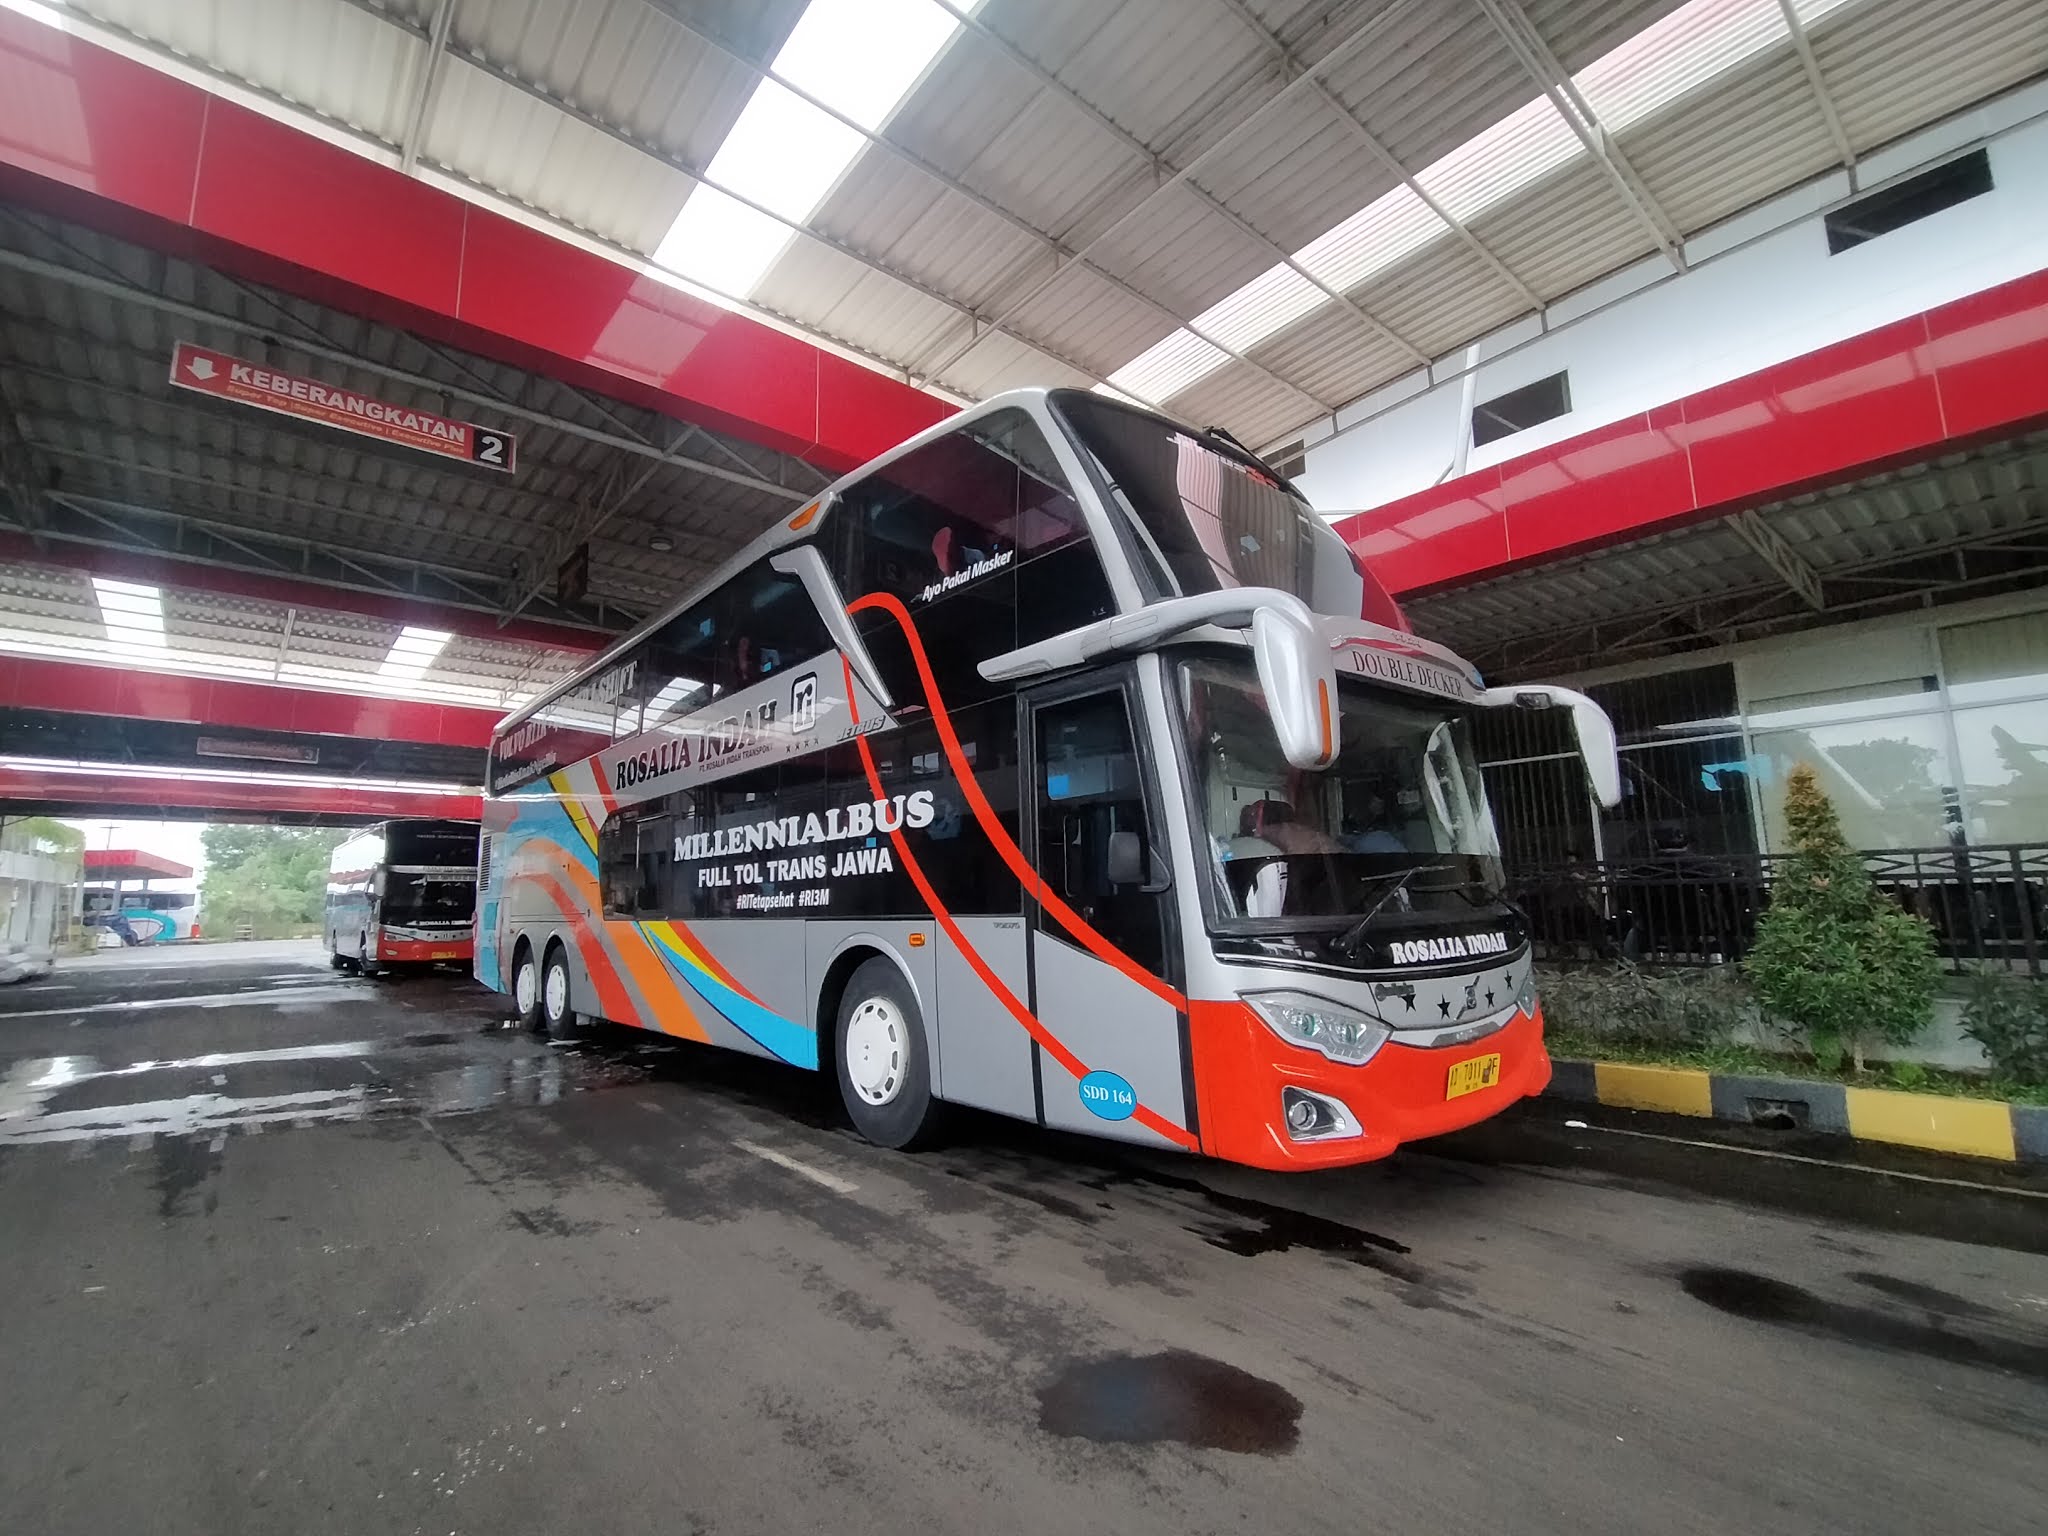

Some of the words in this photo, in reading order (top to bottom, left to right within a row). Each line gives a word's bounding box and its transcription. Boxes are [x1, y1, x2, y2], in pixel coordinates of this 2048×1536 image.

[230, 363, 465, 442] KEBERANGKATAN
[479, 435, 502, 464] 2
[922, 584, 941, 602] Ayo
[942, 566, 971, 592] Pakai
[971, 550, 1013, 579] Masker
[1352, 650, 1416, 683] DOUBLE
[1417, 665, 1464, 698] DECKER
[616, 736, 692, 790] ROSALIA
[697, 698, 778, 763] INDAH
[706, 758, 725, 771] ROSALIA
[673, 789, 935, 863] MILLENNIALBUS
[698, 868, 731, 888] FULL
[733, 863, 763, 885] TOL
[766, 854, 827, 883] TRANS
[831, 847, 893, 877] JAWA
[736, 891, 795, 913] #RITetapsehat
[798, 888, 830, 907] #RI3M
[1389, 936, 1468, 965] ROSALIA
[1465, 932, 1508, 955] INDAH
[1083, 1084, 1109, 1101] SDD
[1112, 1089, 1132, 1106] 164
